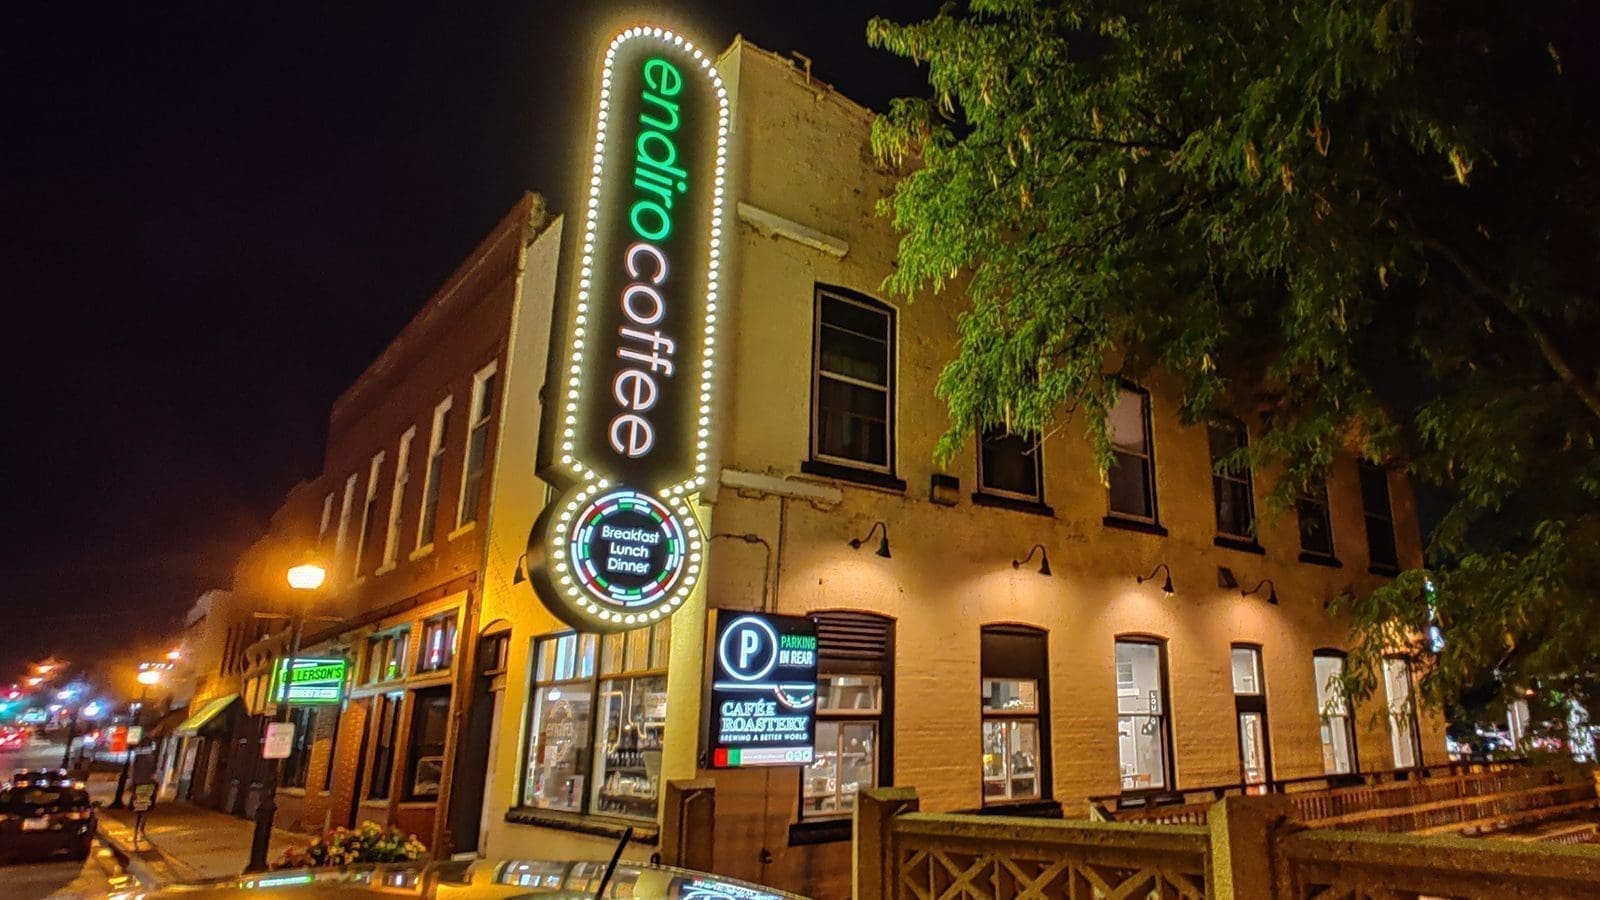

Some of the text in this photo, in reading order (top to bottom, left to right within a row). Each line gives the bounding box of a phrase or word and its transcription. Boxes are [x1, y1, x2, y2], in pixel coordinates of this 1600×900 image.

[629, 56, 688, 241] endiro
[608, 243, 676, 458] coffee
[602, 525, 660, 544] Breakfast
[610, 542, 649, 558] Lunch
[607, 557, 650, 574] Dinner
[740, 629, 758, 669] P
[781, 635, 816, 649] PARKING
[779, 650, 813, 665] IN REAR
[721, 716, 808, 732] ROASTERY
[784, 732, 808, 740] WORLD
